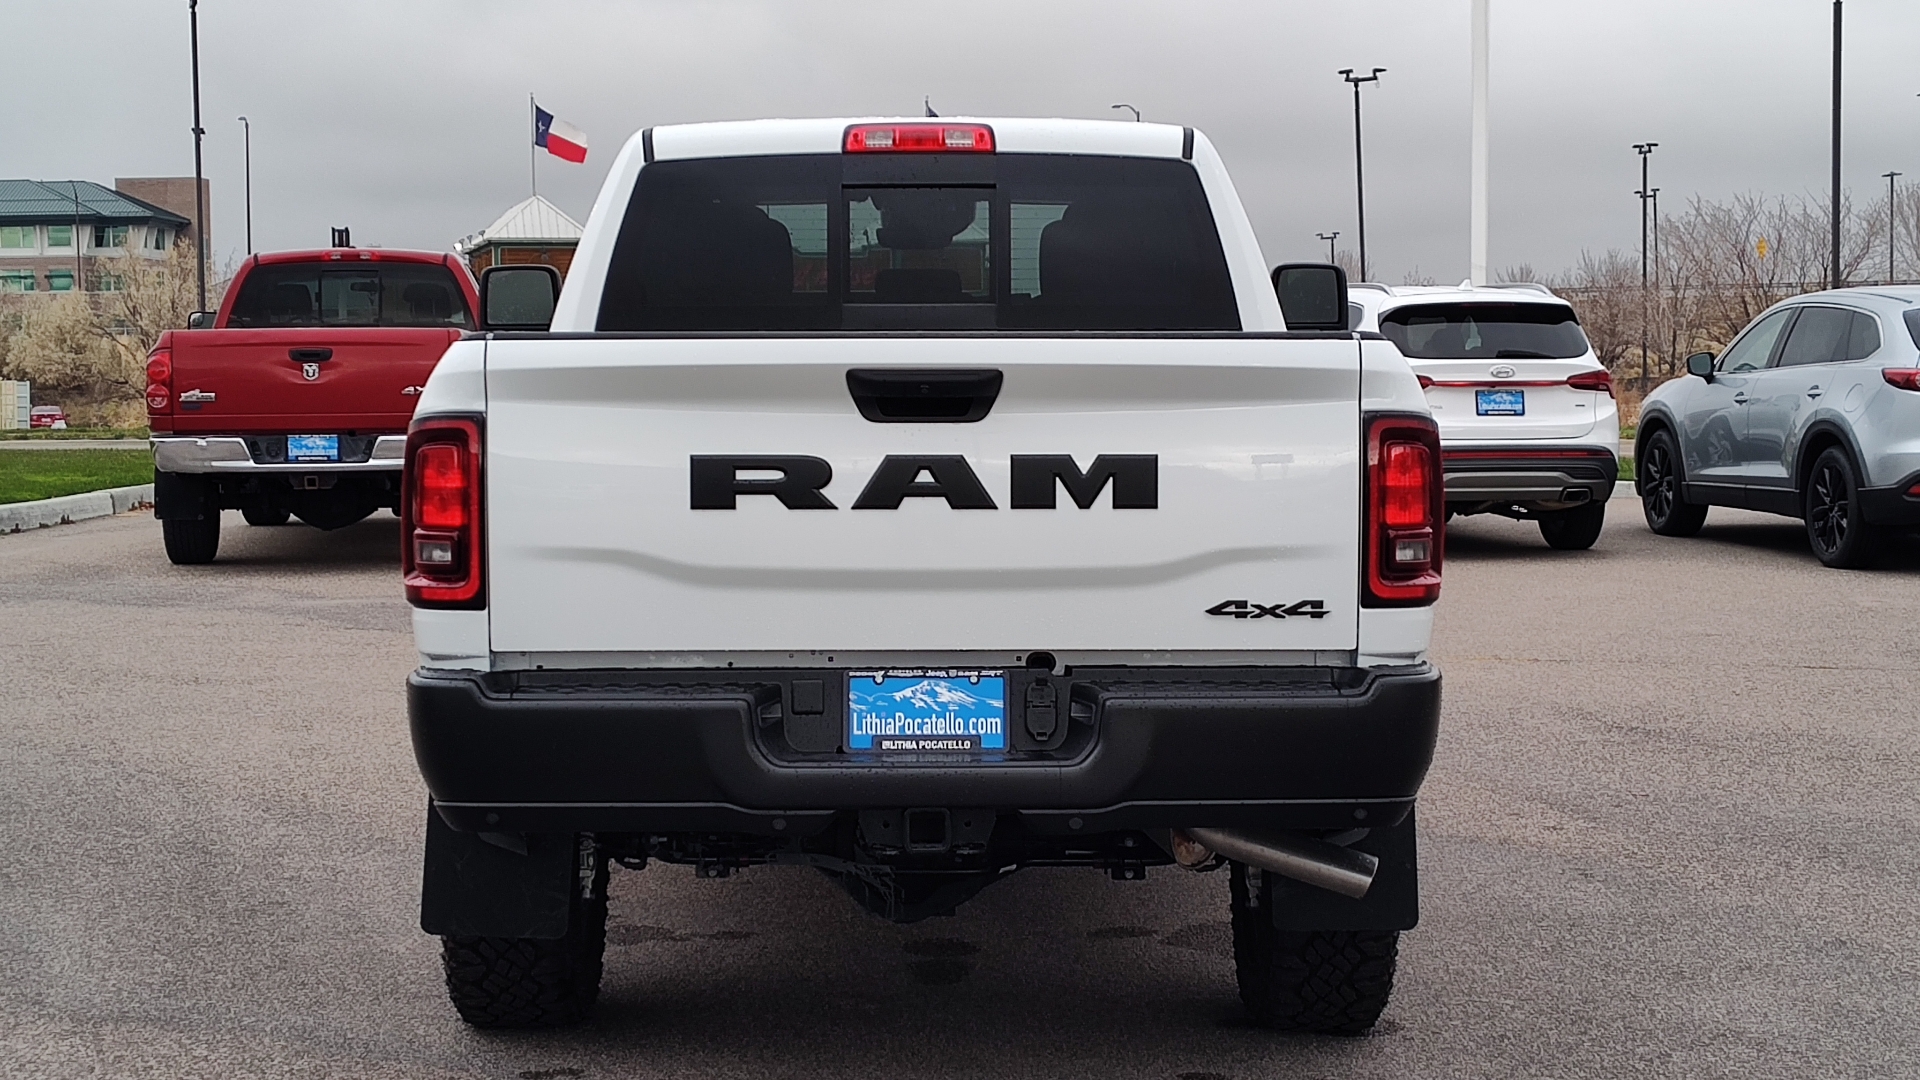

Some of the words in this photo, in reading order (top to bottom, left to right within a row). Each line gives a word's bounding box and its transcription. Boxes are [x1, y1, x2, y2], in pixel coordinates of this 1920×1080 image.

[690, 454, 1159, 510] RAM
[853, 711, 1002, 735] LithiaPocatello.com
[889, 740, 917, 750] LITHIA
[919, 740, 972, 750] POCATELLO
